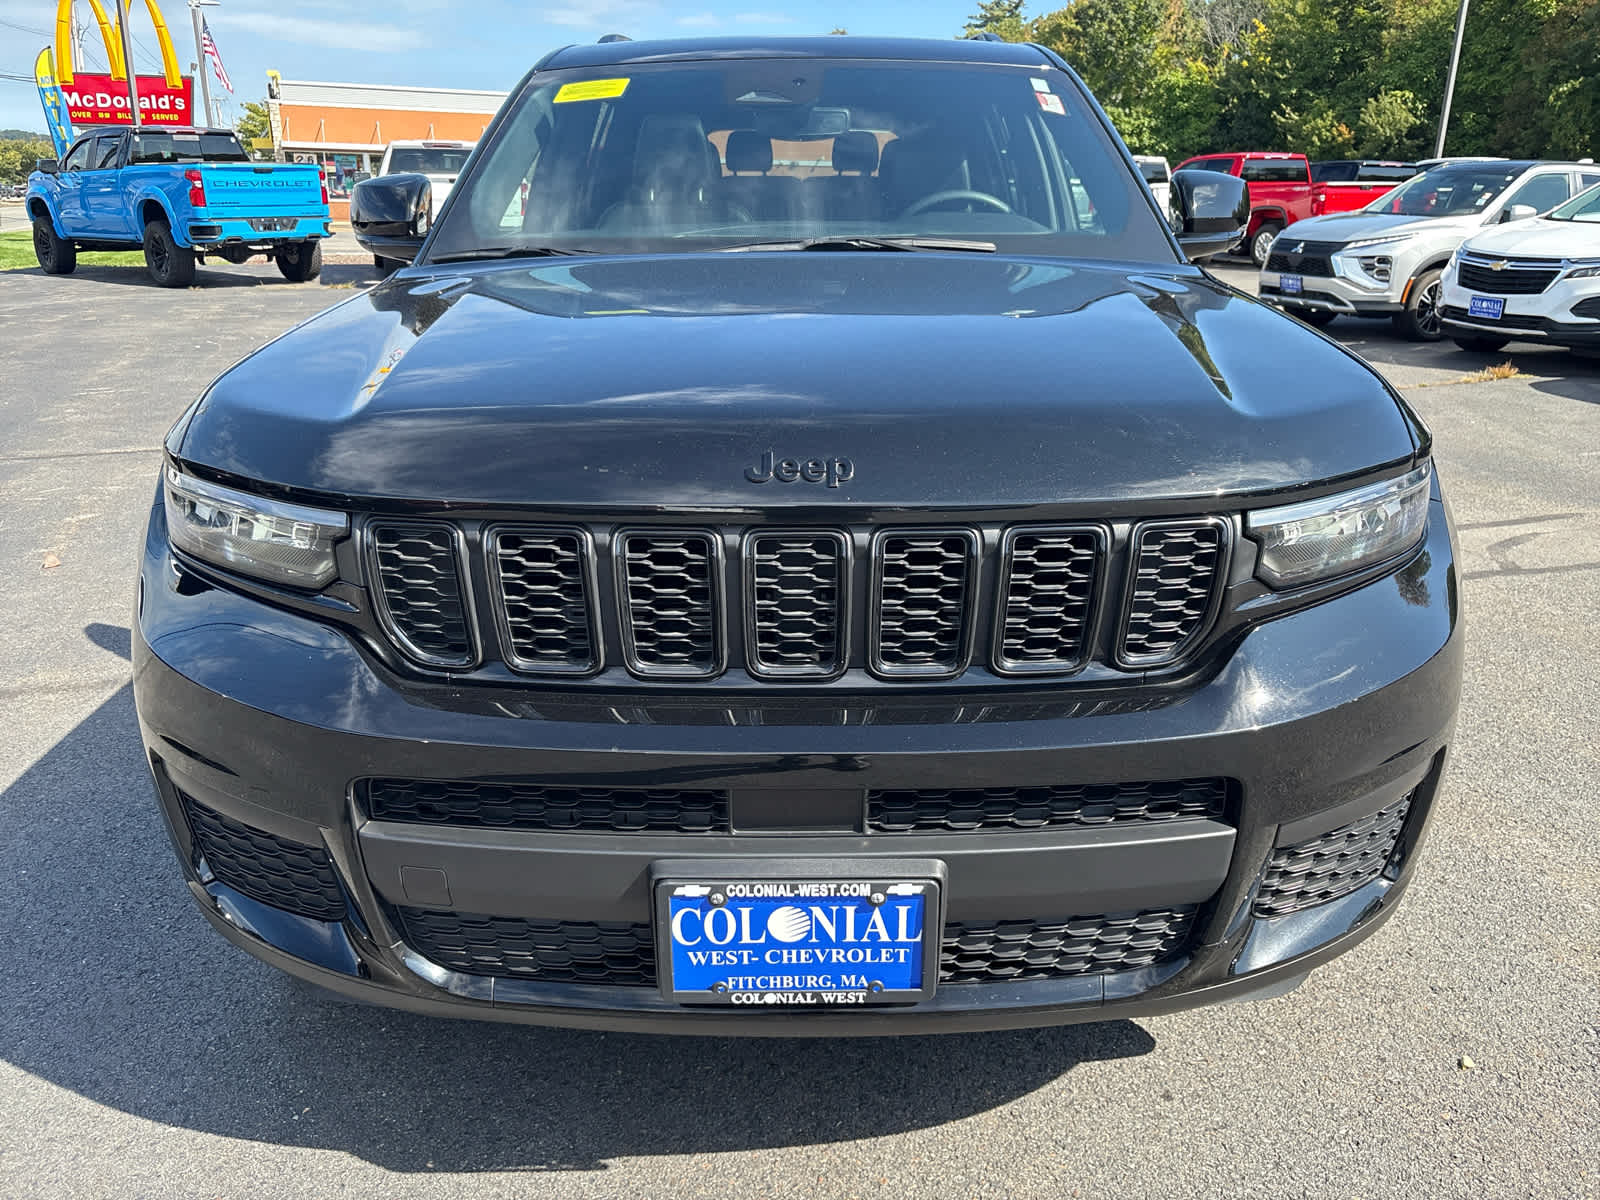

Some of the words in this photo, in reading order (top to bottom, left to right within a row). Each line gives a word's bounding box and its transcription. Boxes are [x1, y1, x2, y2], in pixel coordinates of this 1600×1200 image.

[117, 112, 146, 120] BILLN
[152, 113, 179, 121] SERVED
[213, 180, 313, 188] CHEVROLET
[744, 450, 855, 488] Jeep
[726, 884, 871, 898] COLONIAL-WEST.COM
[671, 905, 923, 946] COLONIAL
[765, 948, 910, 965] CHEVROLET
[728, 976, 836, 990] FITCHBURG,
[840, 975, 869, 989] MA
[730, 992, 817, 1004] COLONIAL
[821, 992, 867, 1004] WEST
